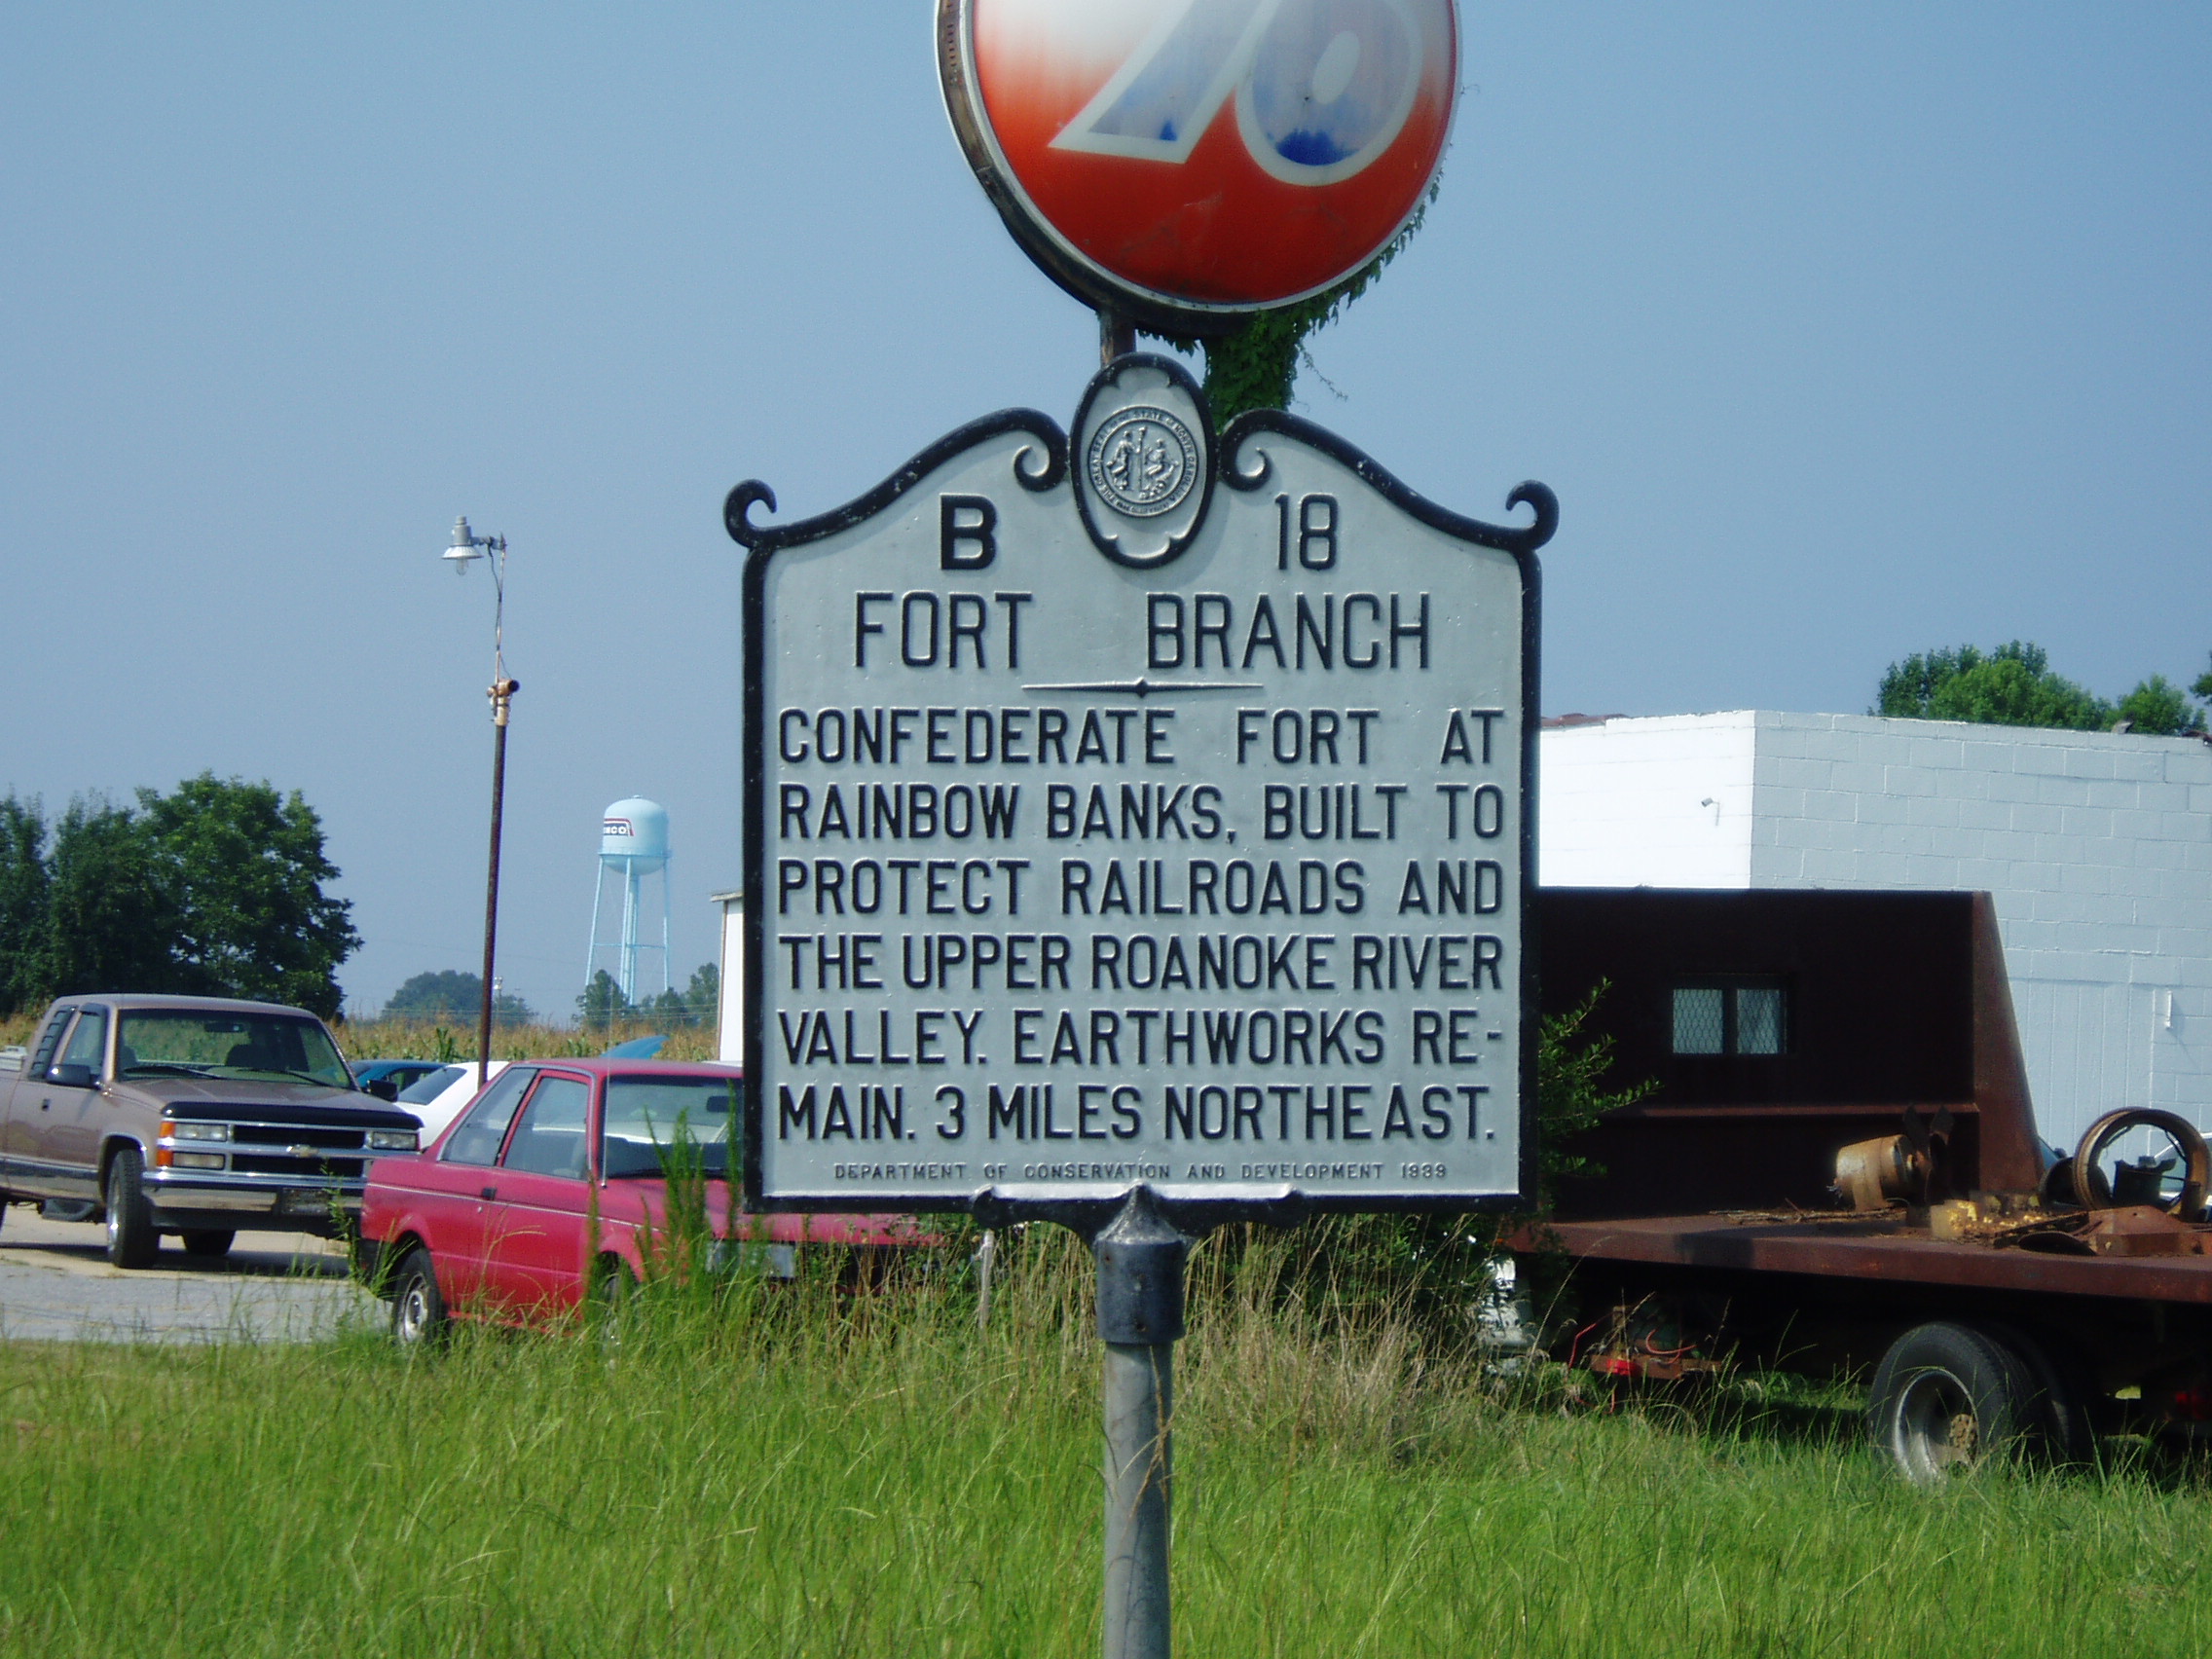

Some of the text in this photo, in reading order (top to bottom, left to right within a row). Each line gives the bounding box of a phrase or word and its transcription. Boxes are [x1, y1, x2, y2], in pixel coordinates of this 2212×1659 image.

[940, 495, 998, 571] B
[1274, 494, 1339, 572] 18
[856, 592, 1429, 671] FORT BRANCH
[779, 708, 1504, 765] CONFEDERATE FORT AT
[780, 784, 1504, 844] RAINBOW BANKS, BUILT TO
[779, 860, 1503, 916] PROTECT RAILROADS AND
[779, 935, 1503, 991] THE UPPER ROANOKE RIVER
[778, 1010, 1502, 1066] VALLEY. EARTHWORKS RE-
[779, 1085, 1494, 1141] MAIN. 3 MILES NORTHEAST.
[834, 1163, 967, 1180] DEPARTMENT
[983, 1163, 1008, 1180] OF
[1024, 1163, 1170, 1180] CONSERVATION
[1187, 1163, 1226, 1180] AND
[1241, 1163, 1383, 1180] DEVELOPMENT
